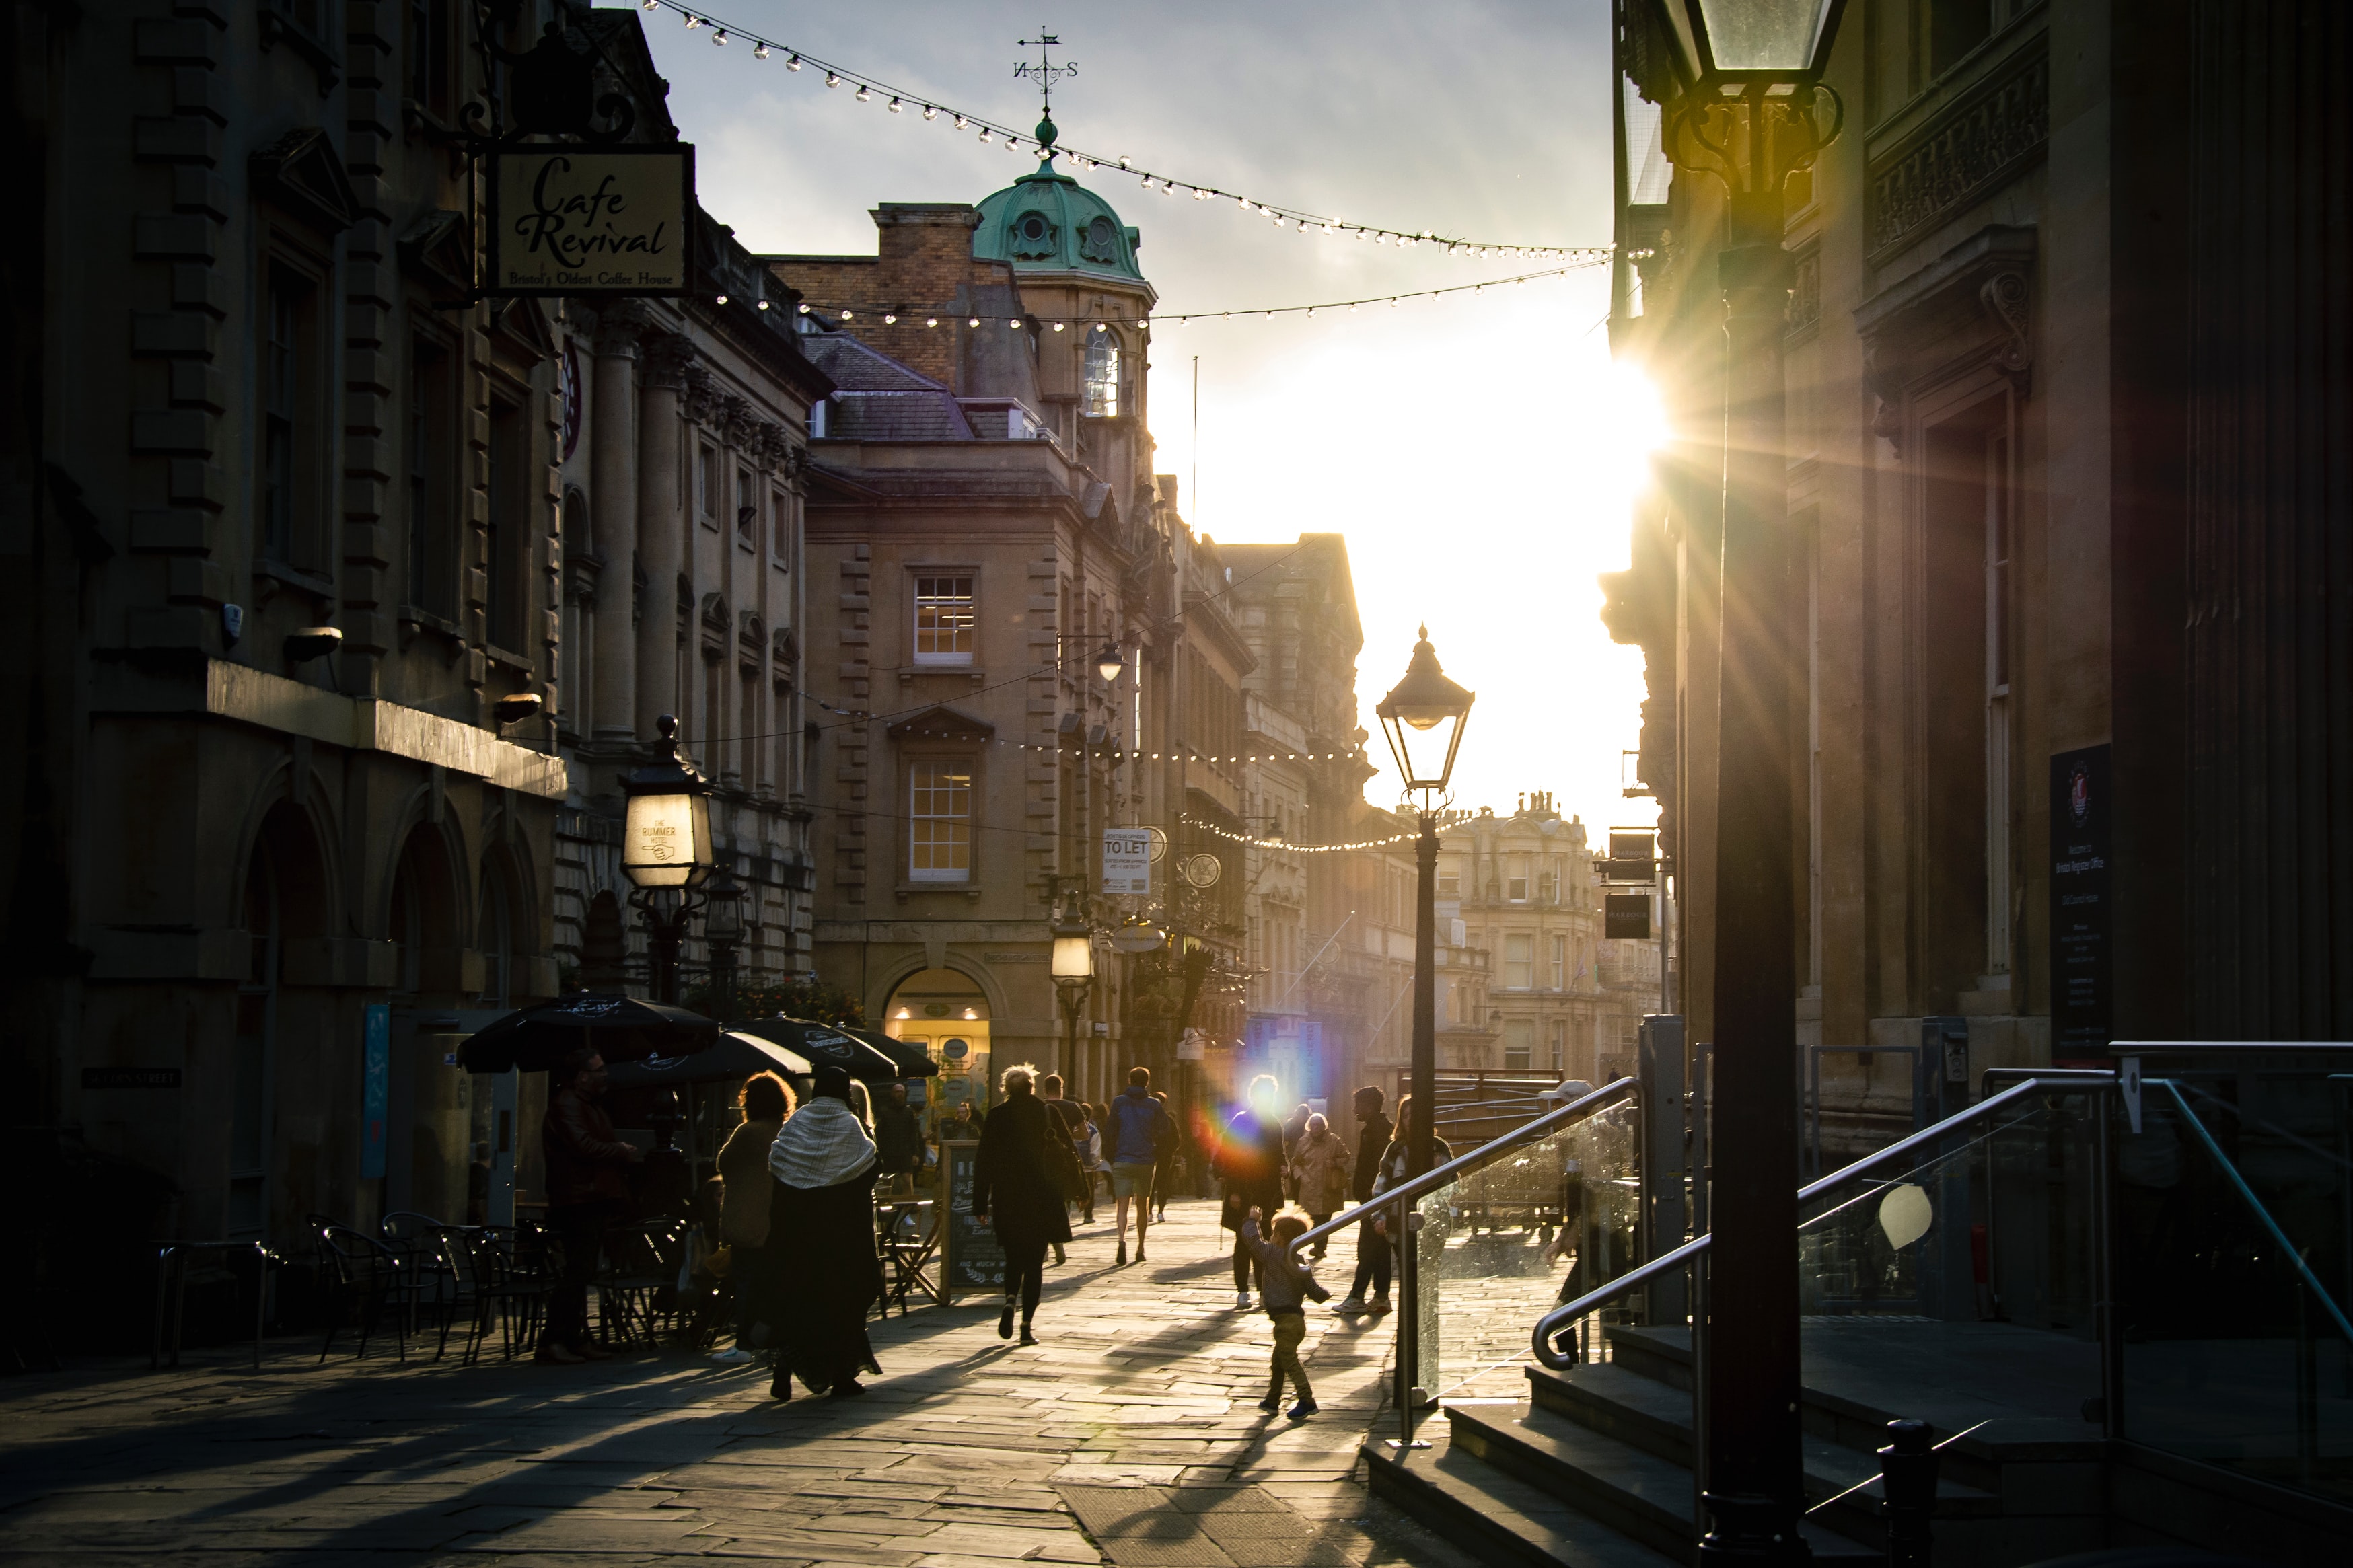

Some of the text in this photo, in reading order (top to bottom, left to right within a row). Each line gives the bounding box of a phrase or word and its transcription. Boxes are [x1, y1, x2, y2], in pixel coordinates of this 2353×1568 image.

[532, 156, 627, 229] Cafe
[515, 213, 668, 269] Revival
[509, 271, 673, 285] Bristol's Oldest Coffee House
[642, 827, 676, 837] RUMMER
[1105, 841, 1147, 854] TO LET
[136, 1073, 175, 1084] STREET
